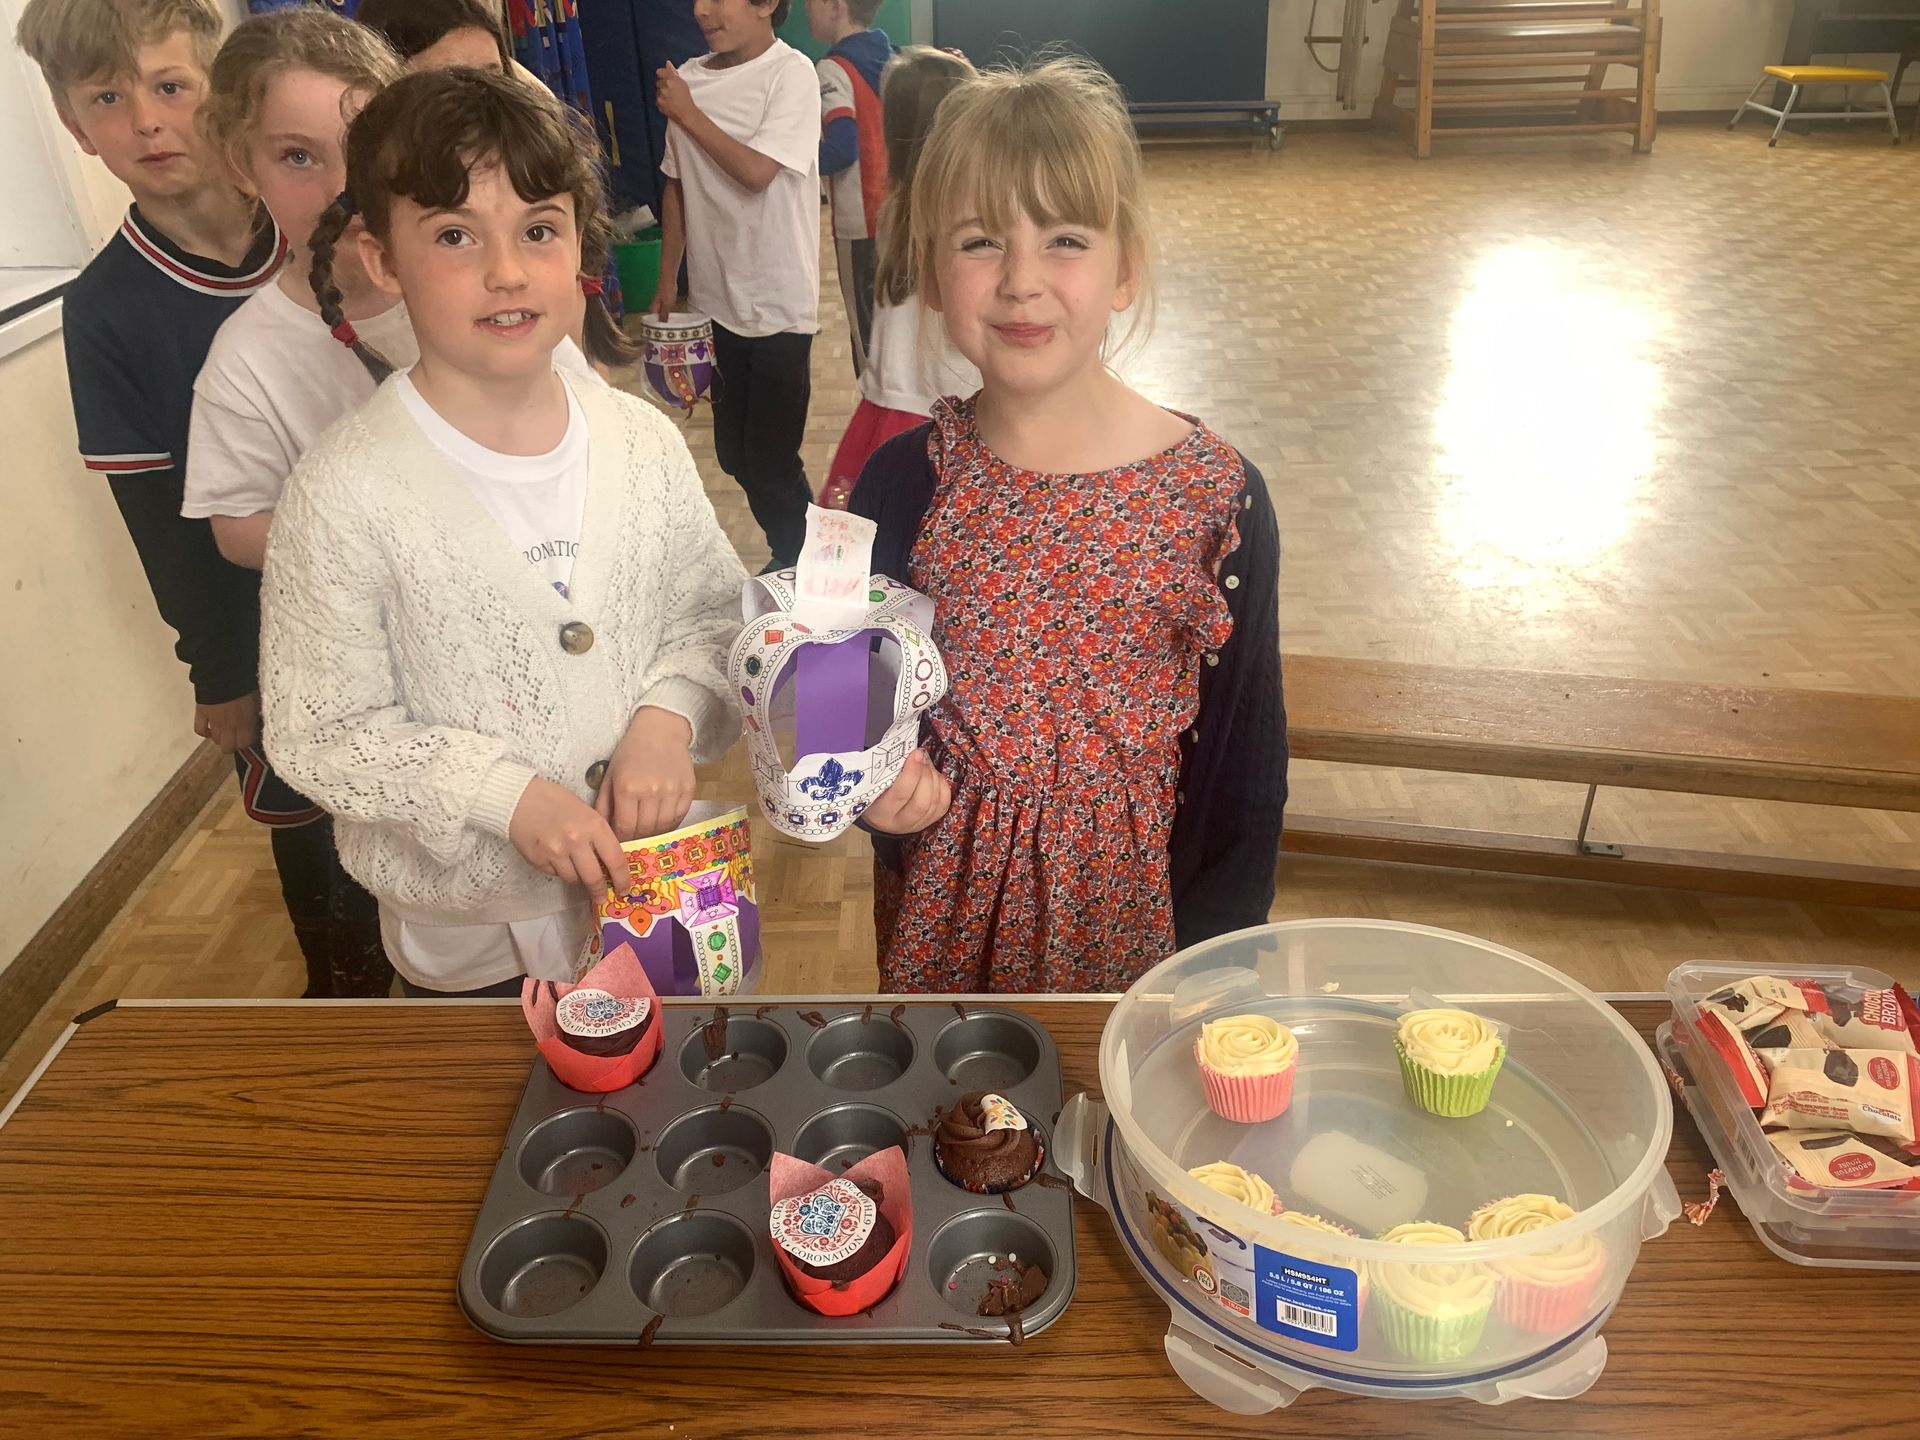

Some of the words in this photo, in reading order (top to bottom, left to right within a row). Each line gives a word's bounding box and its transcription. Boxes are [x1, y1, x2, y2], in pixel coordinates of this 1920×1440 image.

[632, 1005, 646, 1022] KING
[587, 1020, 632, 1034] CHARLES
[1861, 1105, 1902, 1122] Chocolate
[1833, 1160, 1873, 1178] BROMPTON
[791, 1236, 864, 1263] CORONATION
[1333, 1289, 1345, 1297] OZ
